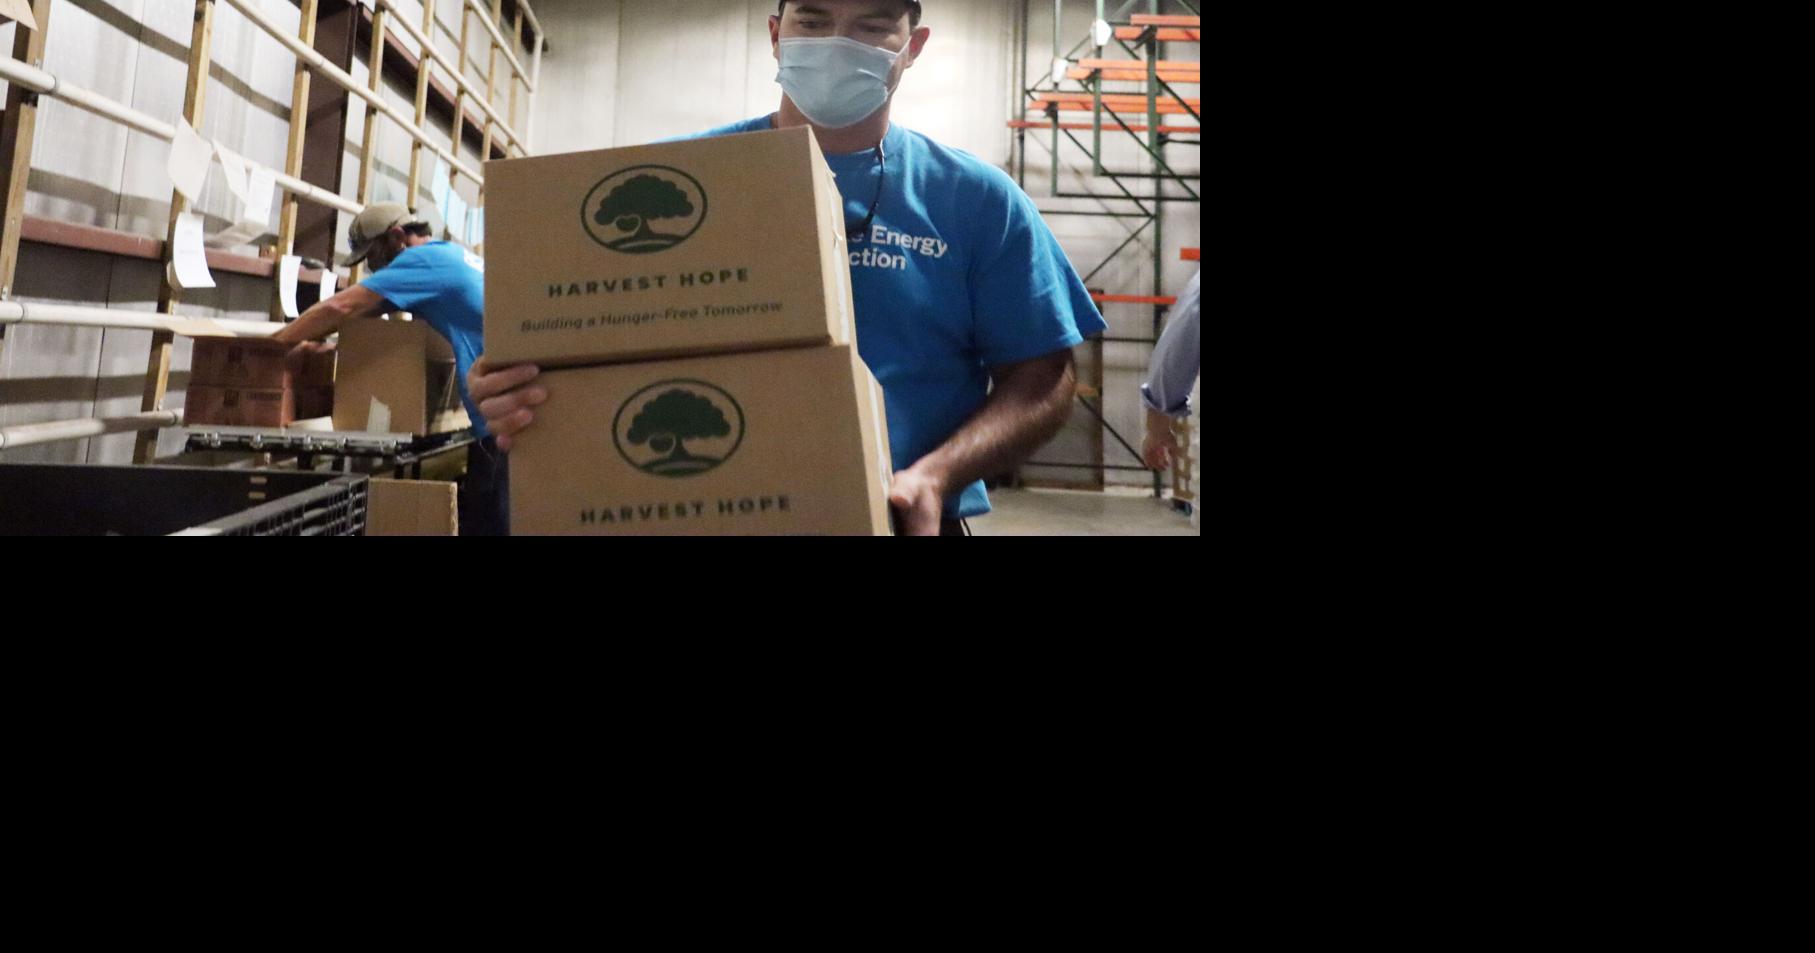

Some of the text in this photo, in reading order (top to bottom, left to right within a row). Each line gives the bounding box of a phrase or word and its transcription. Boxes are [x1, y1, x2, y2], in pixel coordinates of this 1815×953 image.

[871, 224, 948, 258] Energy
[848, 247, 907, 270] ction
[547, 268, 749, 298] HARVEST HOPE
[521, 301, 783, 332] Building a Hunger-Free Tomorrow
[580, 494, 791, 523] HARVEST HOPE
